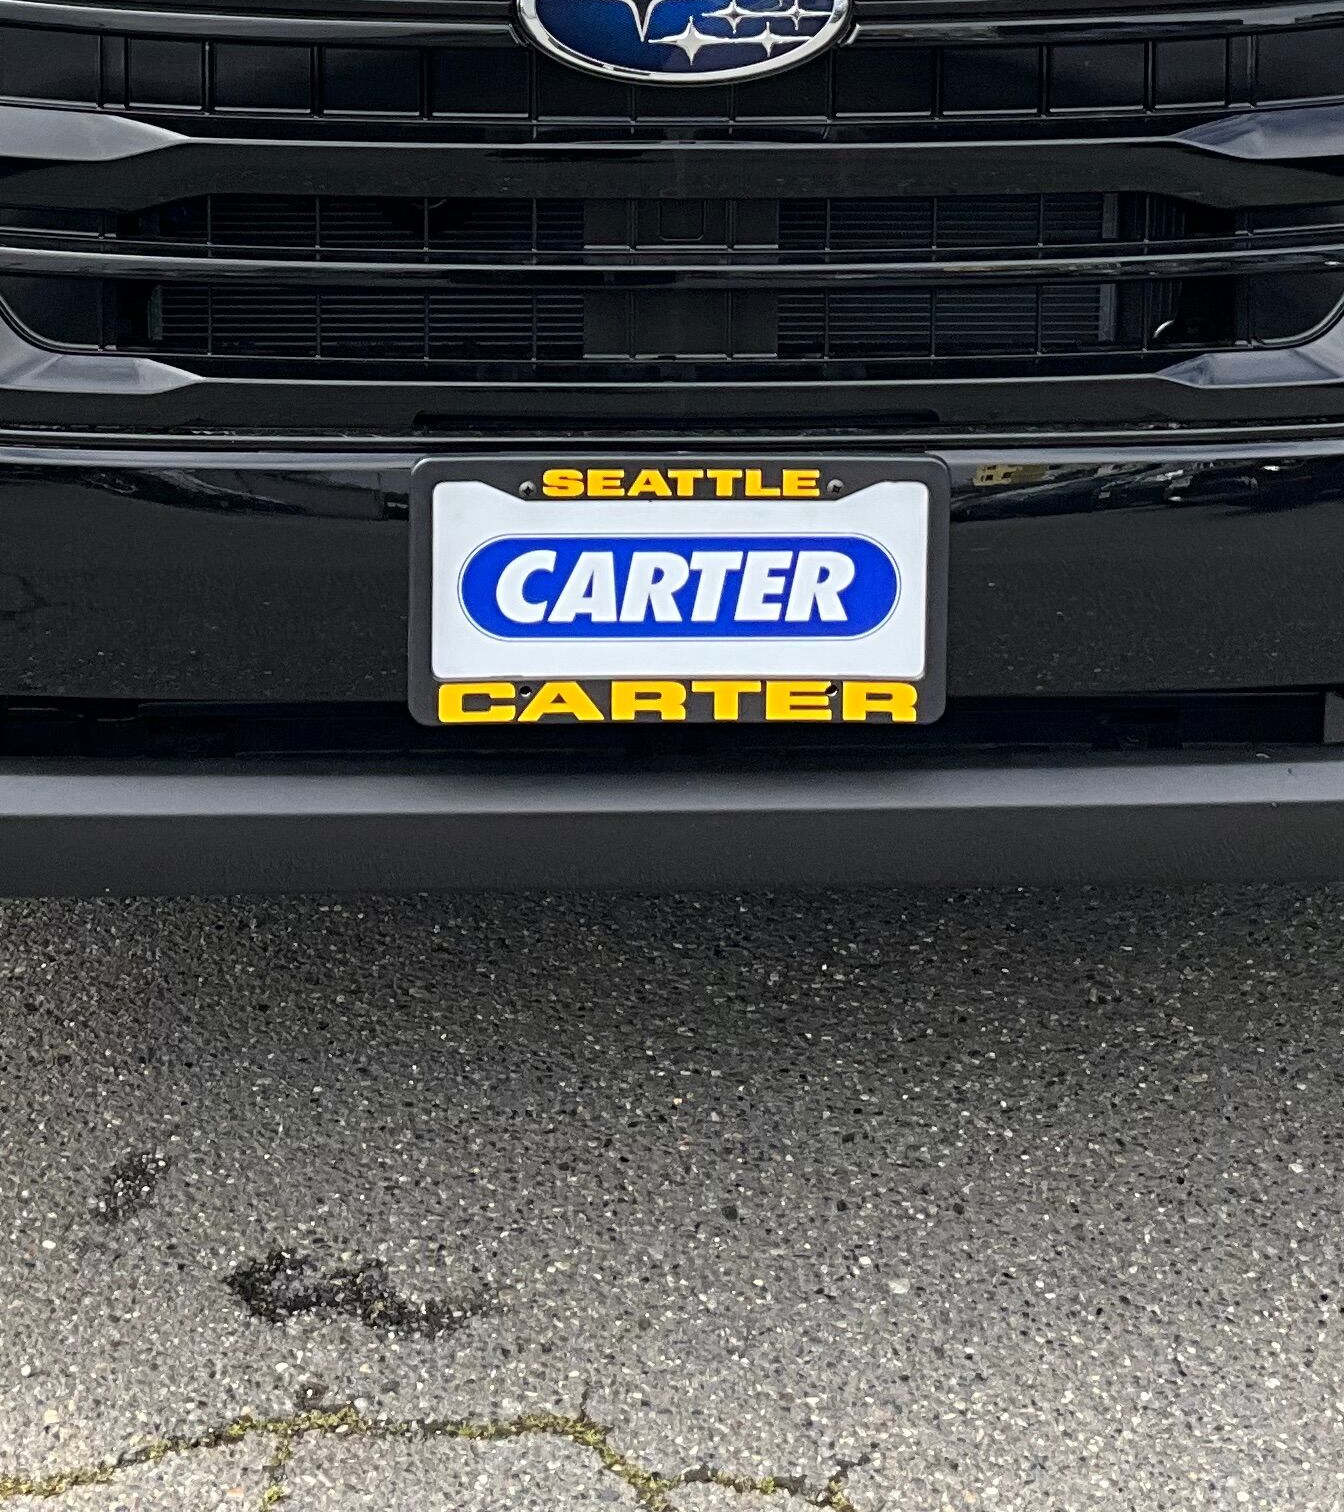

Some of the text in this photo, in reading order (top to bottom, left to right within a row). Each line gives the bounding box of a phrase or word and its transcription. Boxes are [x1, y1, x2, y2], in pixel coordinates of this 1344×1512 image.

[542, 469, 821, 497] SEATTLE
[495, 549, 856, 624] CARTER
[438, 681, 919, 723] CARTER
